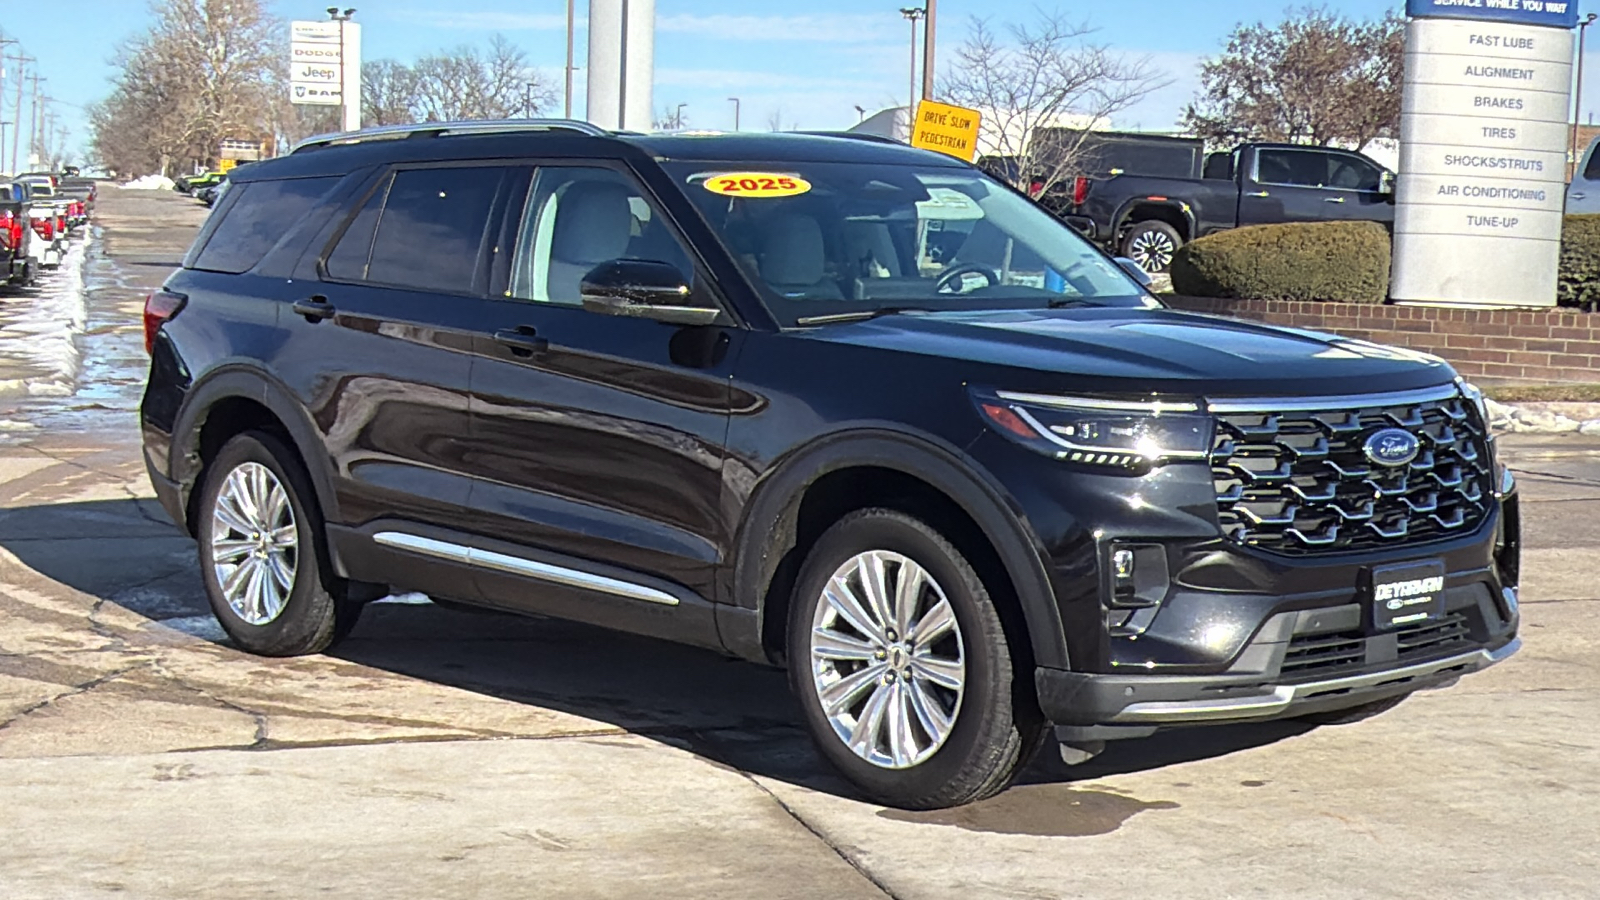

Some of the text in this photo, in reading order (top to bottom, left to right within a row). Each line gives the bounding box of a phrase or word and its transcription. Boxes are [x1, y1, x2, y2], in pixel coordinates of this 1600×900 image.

[1486, 0, 1520, 10] WHILE
[1522, 0, 1543, 12] YOU
[1545, 2, 1567, 13] WAIT
[1469, 34, 1534, 49] FAST LUBE
[302, 66, 334, 79] Jeep
[1464, 65, 1534, 80] ALIGNMENT
[1474, 96, 1523, 110] BRAKES
[924, 111, 971, 129] DRIVE SLOW
[920, 130, 967, 149] PEDESTRIAN
[1481, 126, 1516, 140] TIRES
[1444, 154, 1543, 172] SHOCKS/STRUTS
[719, 178, 796, 191] 2025
[1437, 184, 1545, 201] AIR CONDITIONING
[1467, 215, 1519, 229] TUNE-UP
[1380, 436, 1409, 453] Ford
